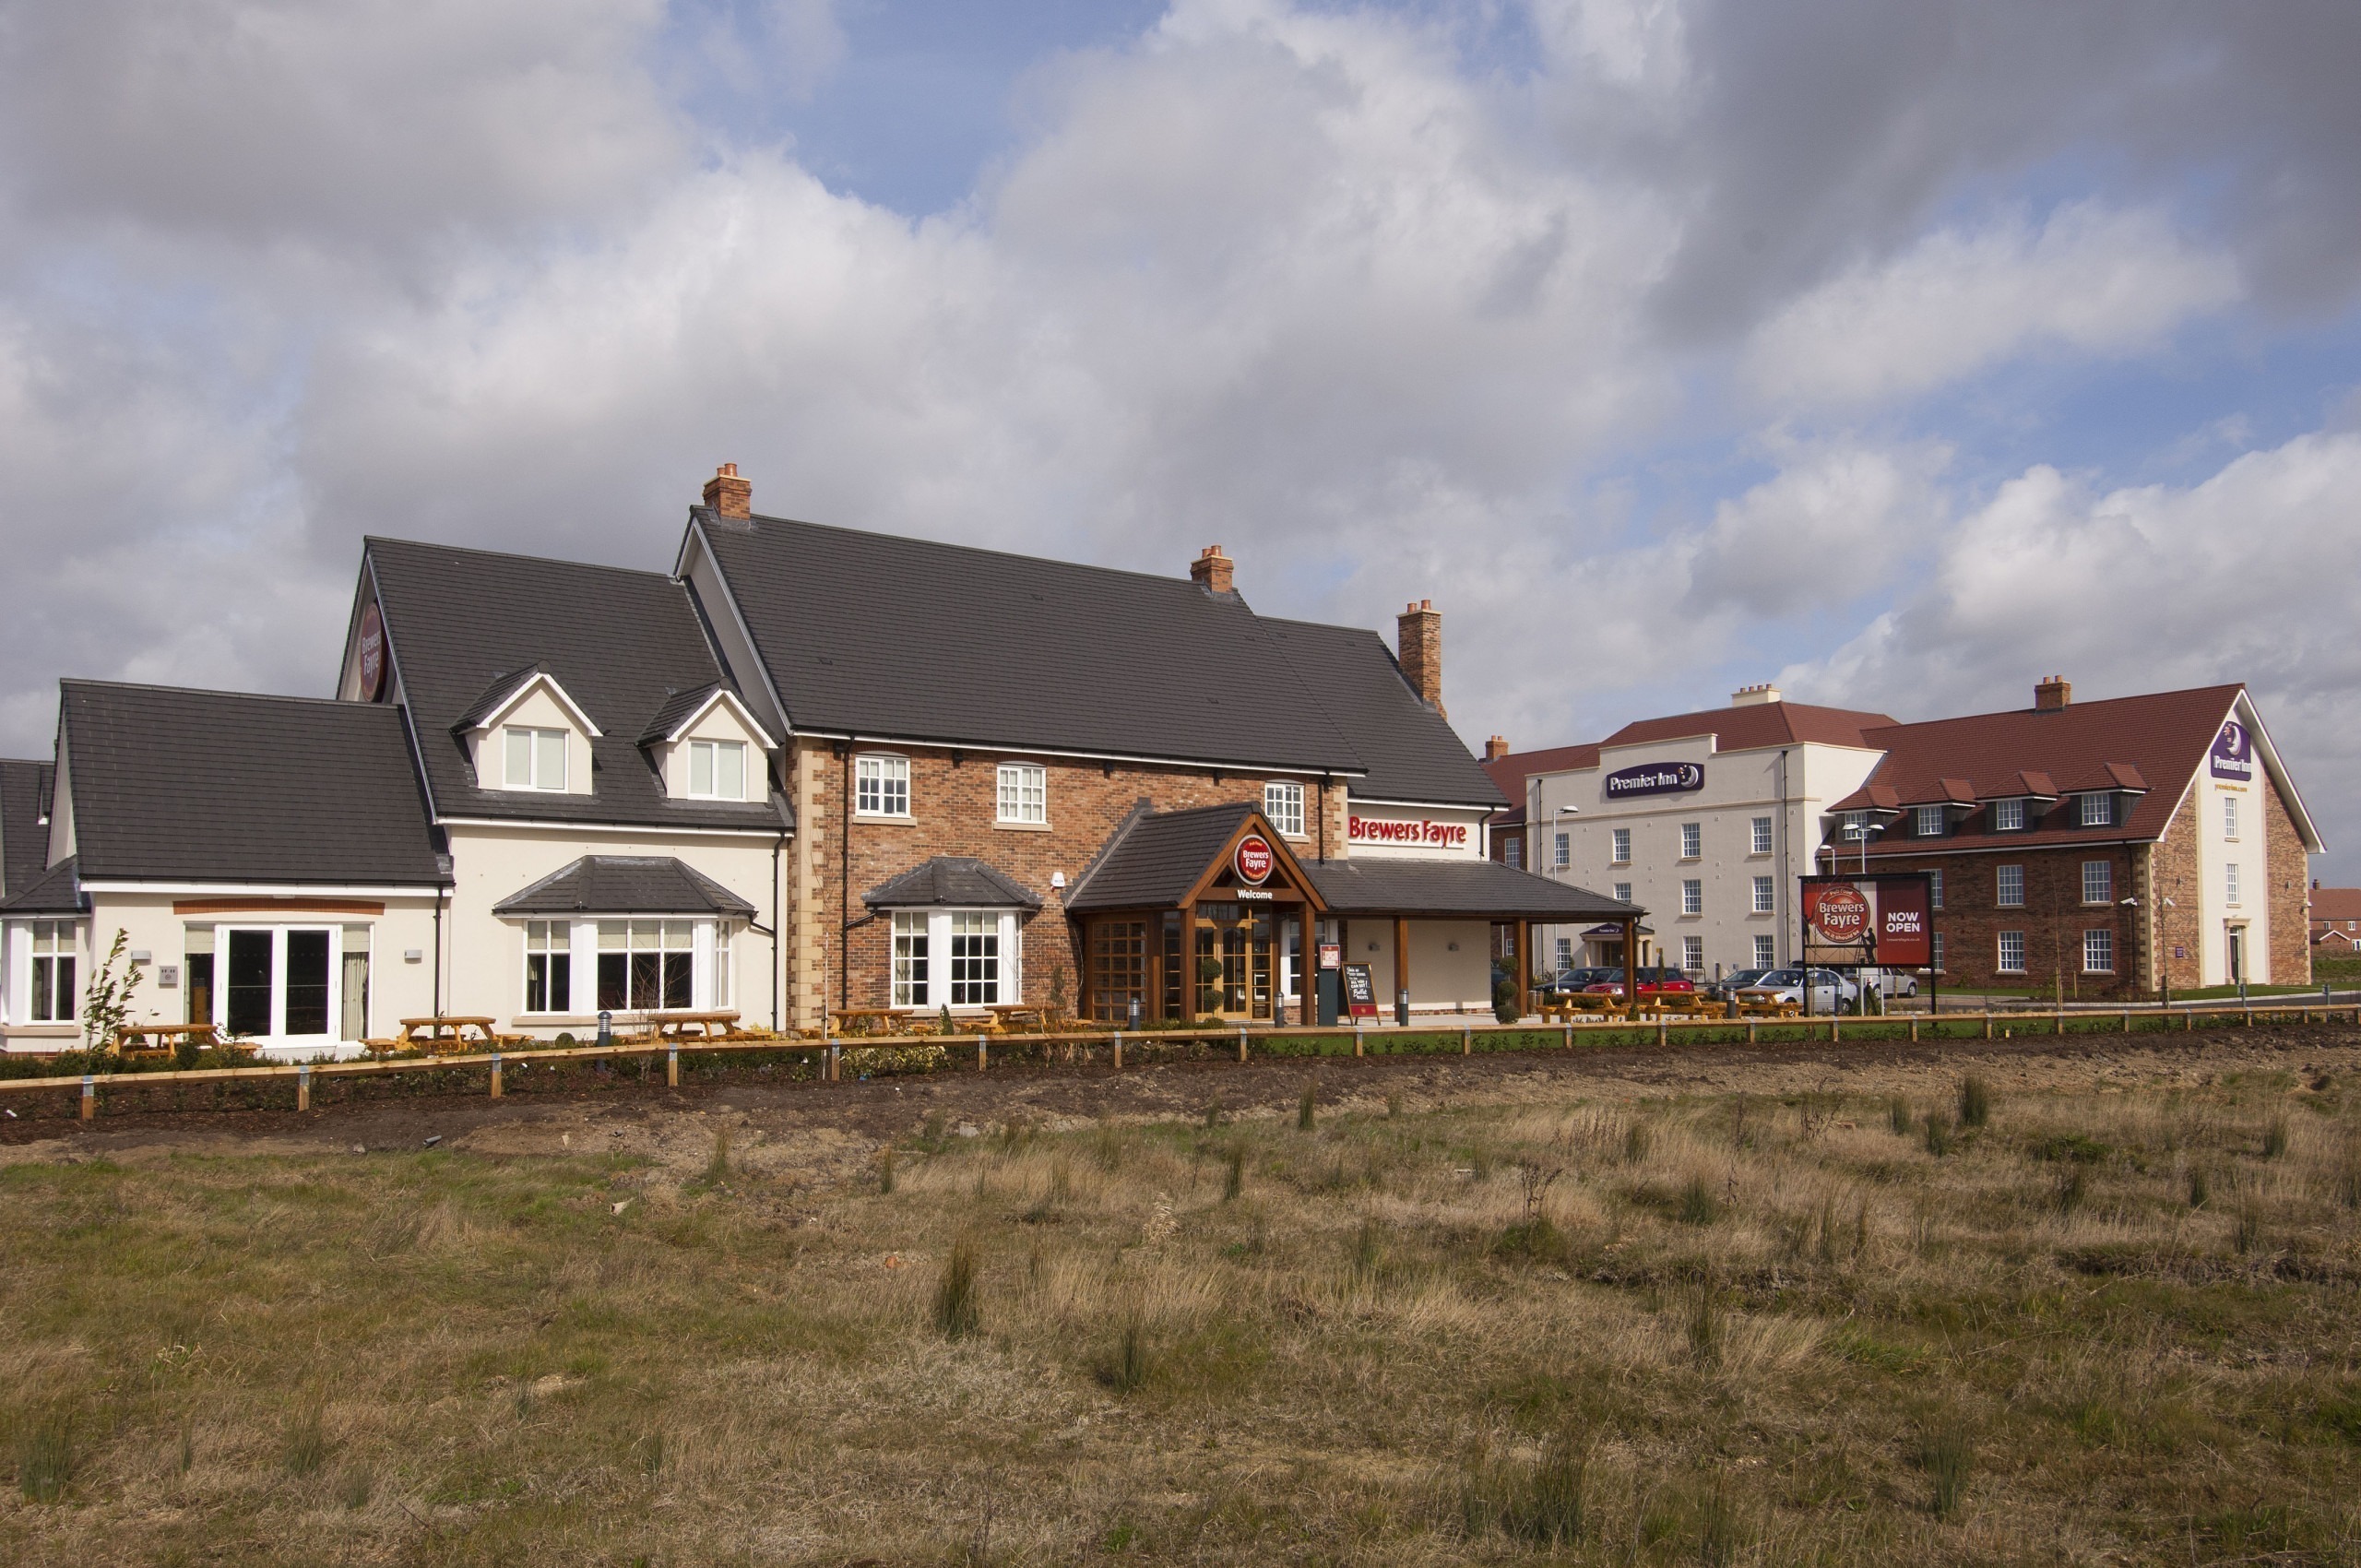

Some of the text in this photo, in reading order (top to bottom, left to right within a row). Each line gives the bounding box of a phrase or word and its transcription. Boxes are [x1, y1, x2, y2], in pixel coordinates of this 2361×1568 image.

[362, 630, 381, 654] Brewers
[364, 651, 379, 678] Fayre
[2213, 755, 2251, 772] Premier Inn
[1610, 772, 1678, 790] Premier Inn
[1349, 816, 1466, 848] Brewers Fayre
[1243, 850, 1269, 859] Brewers
[1245, 858, 1266, 871] Fayre
[1237, 889, 1273, 899] Welcome
[1819, 902, 1865, 913] Brewers
[1823, 913, 1860, 929] Fayre
[1888, 912, 1919, 922] NOW
[1886, 922, 1920, 932] OPEN
